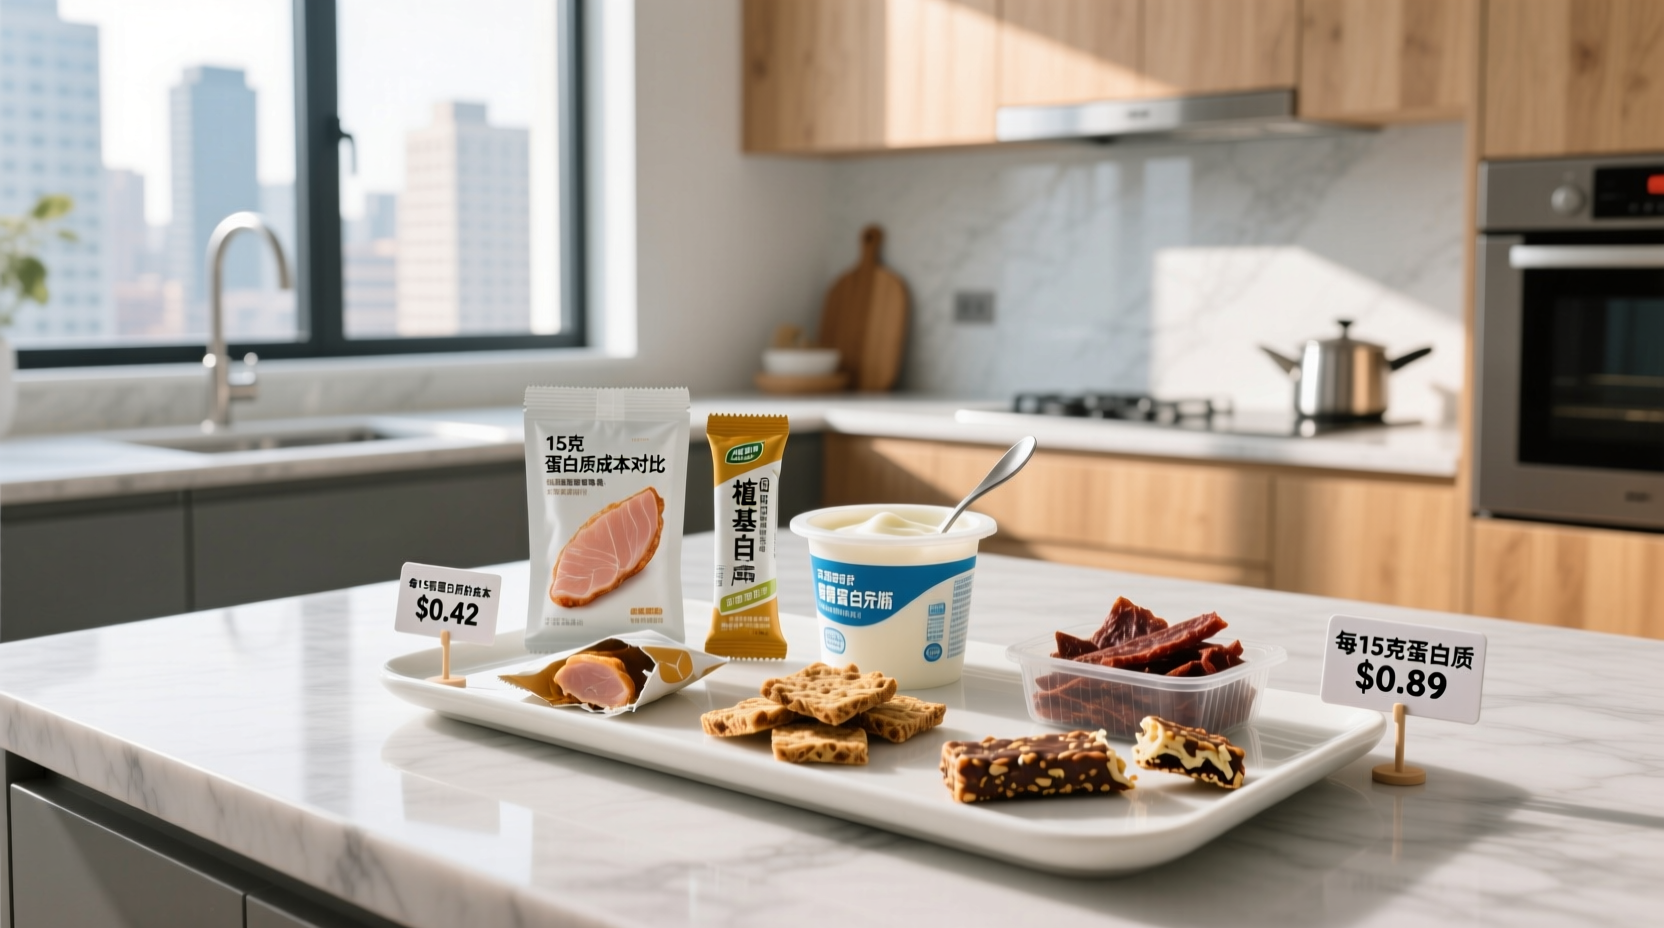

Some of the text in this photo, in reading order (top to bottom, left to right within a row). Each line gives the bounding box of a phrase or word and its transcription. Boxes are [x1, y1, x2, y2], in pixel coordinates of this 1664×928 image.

[546, 434, 585, 452] 15克
[545, 454, 666, 474] 蛋白质成本对比
[415, 594, 479, 626] $0.42
[1335, 630, 1475, 670] 每15克蛋白质
[1355, 658, 1448, 699] $0.89
